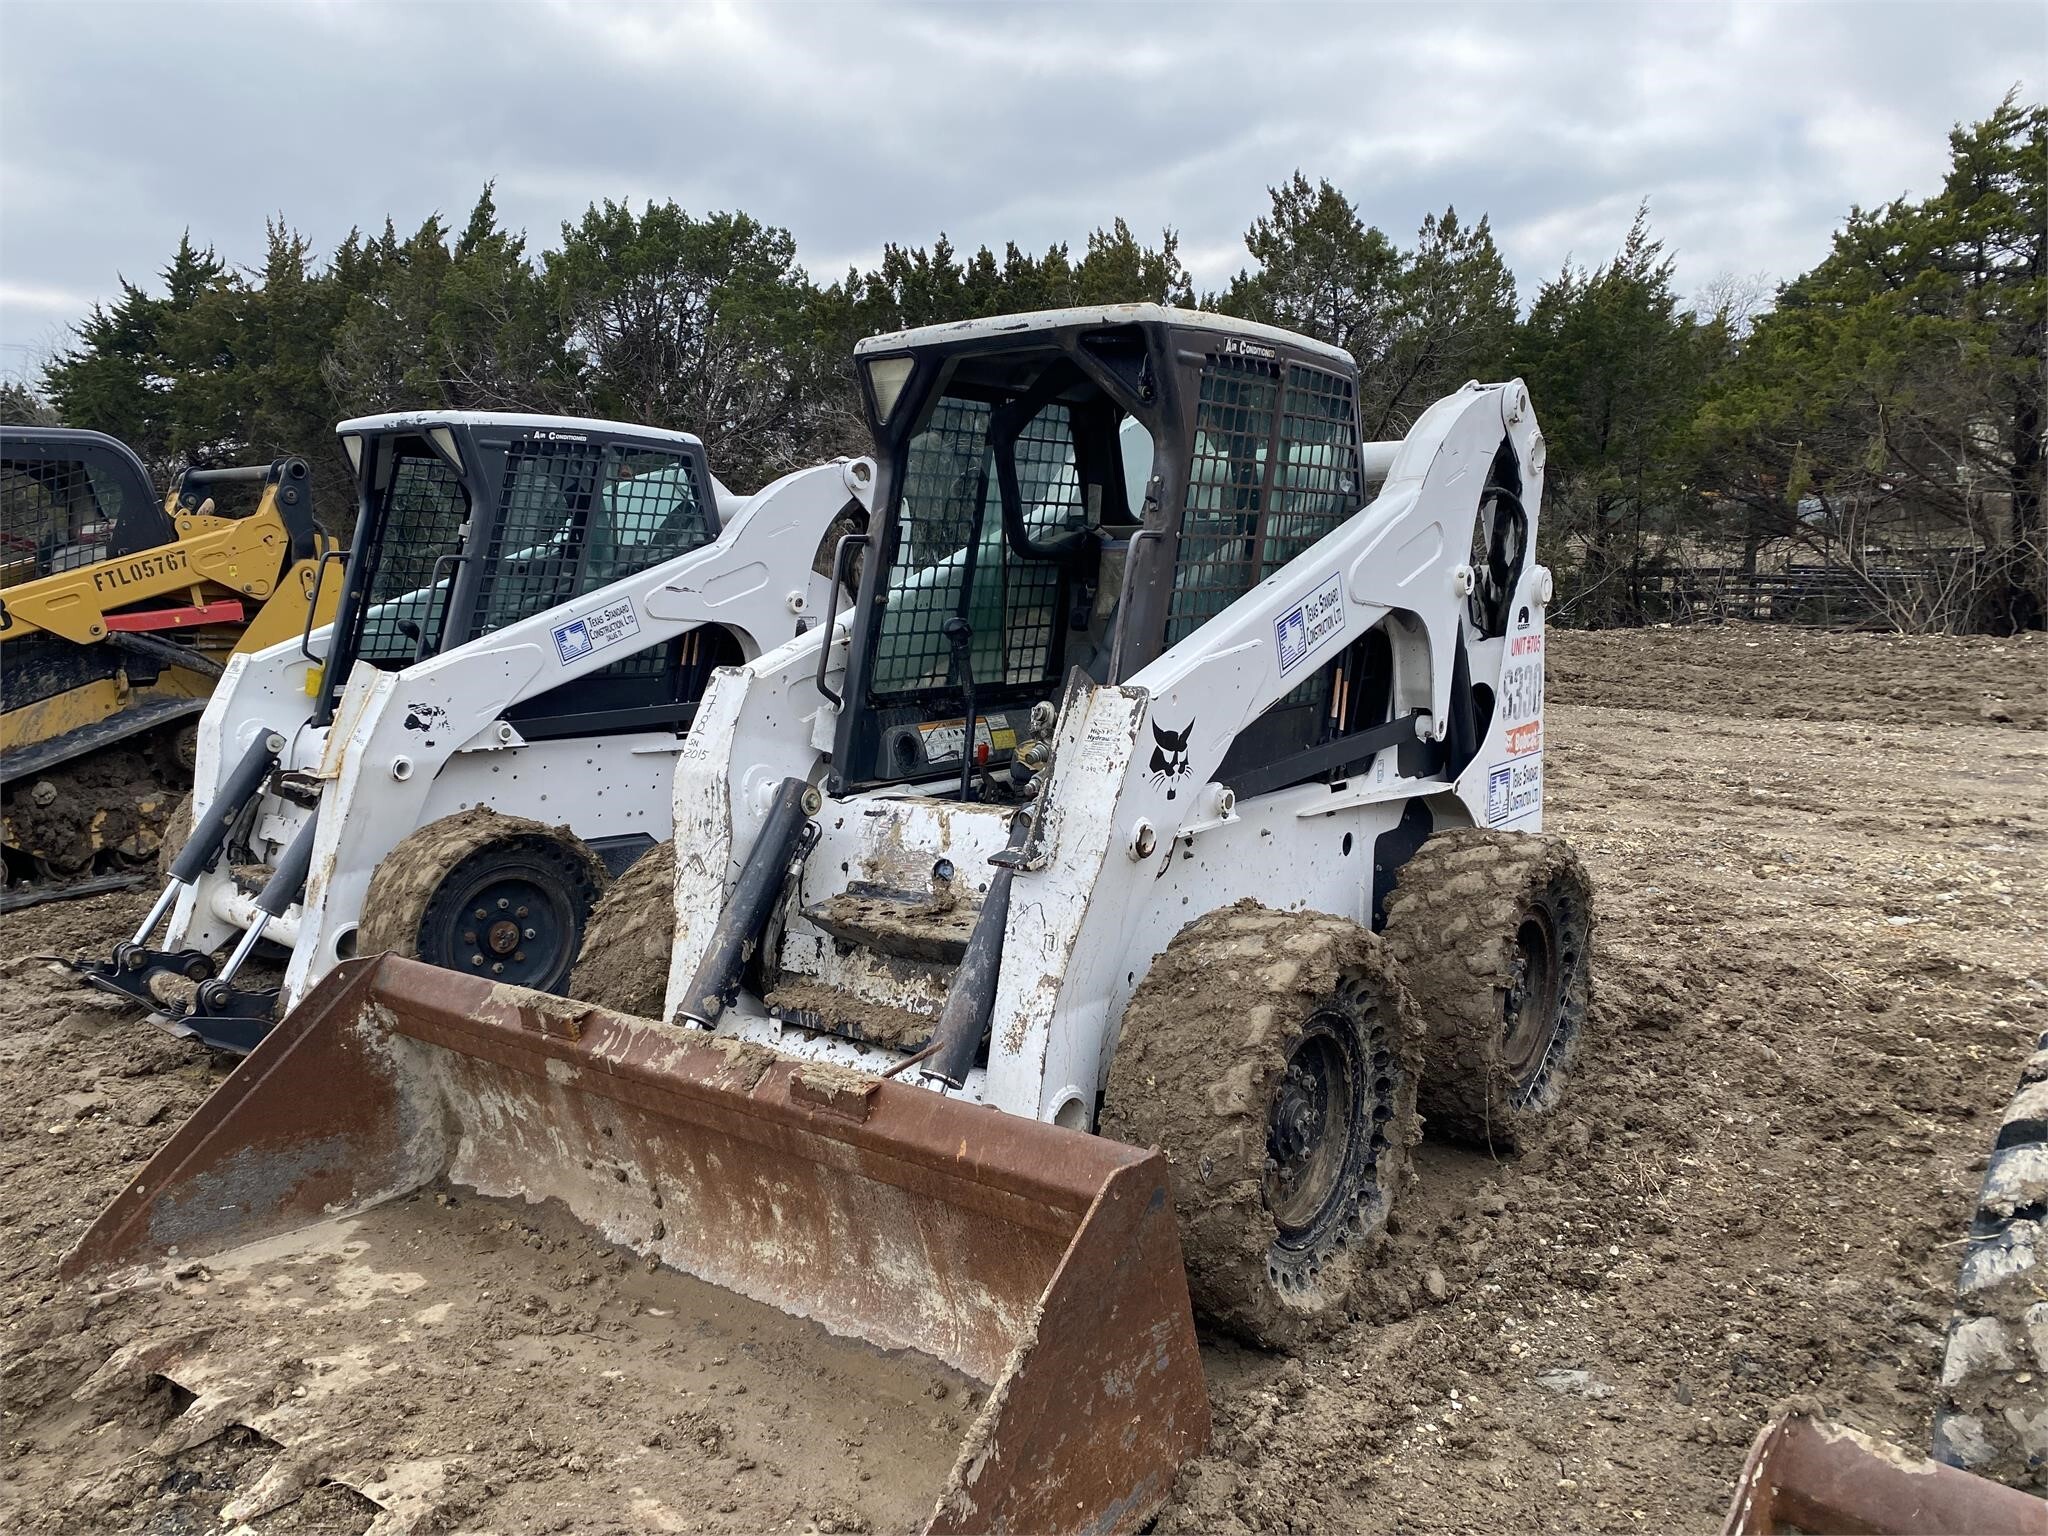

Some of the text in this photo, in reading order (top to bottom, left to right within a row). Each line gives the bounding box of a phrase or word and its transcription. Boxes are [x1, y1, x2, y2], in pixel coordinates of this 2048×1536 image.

[93, 550, 187, 592] FTL05767
[1502, 662, 1542, 721] S330
[683, 748, 710, 761] 2015
